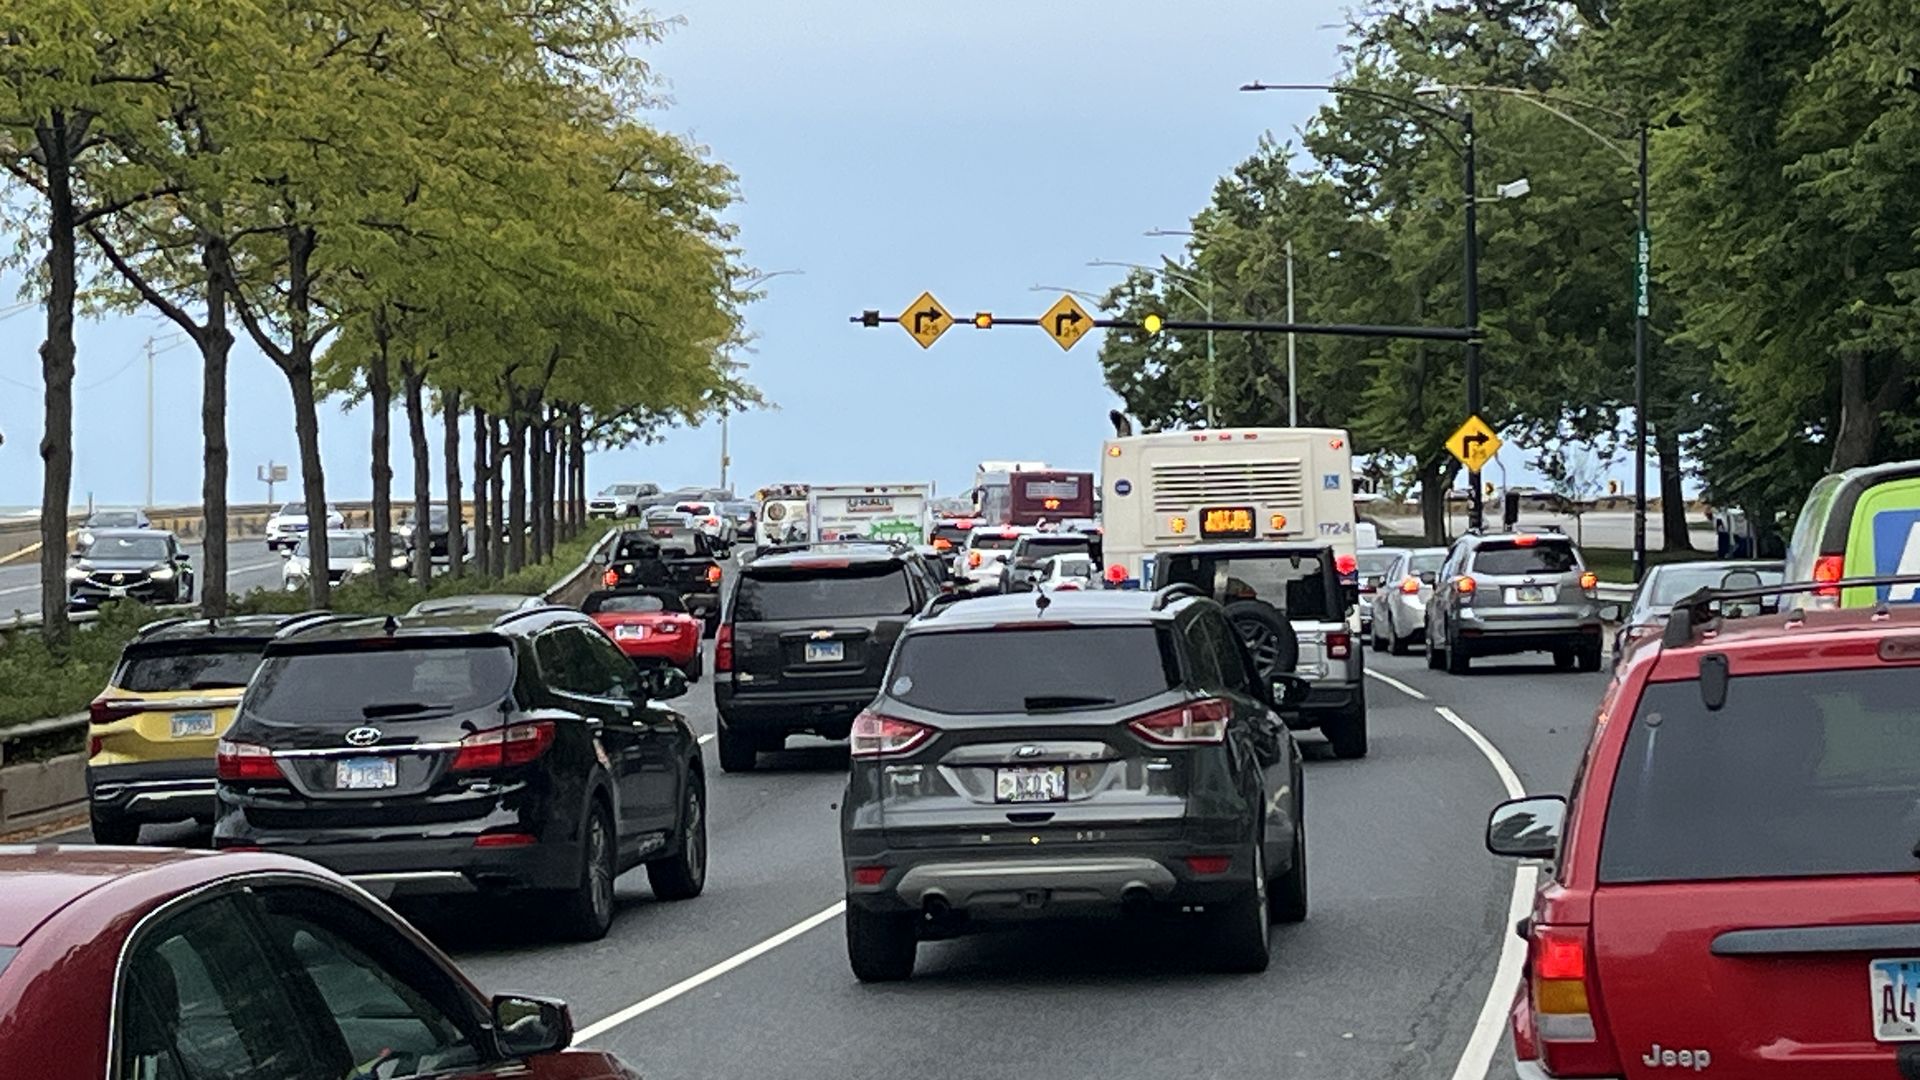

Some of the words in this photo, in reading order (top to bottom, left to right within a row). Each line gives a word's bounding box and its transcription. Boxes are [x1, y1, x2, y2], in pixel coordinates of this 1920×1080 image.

[921, 323, 940, 336] 25
[1063, 325, 1081, 338] 25
[1319, 521, 1351, 535] 1724
[1641, 1043, 1712, 1071] Jeep
